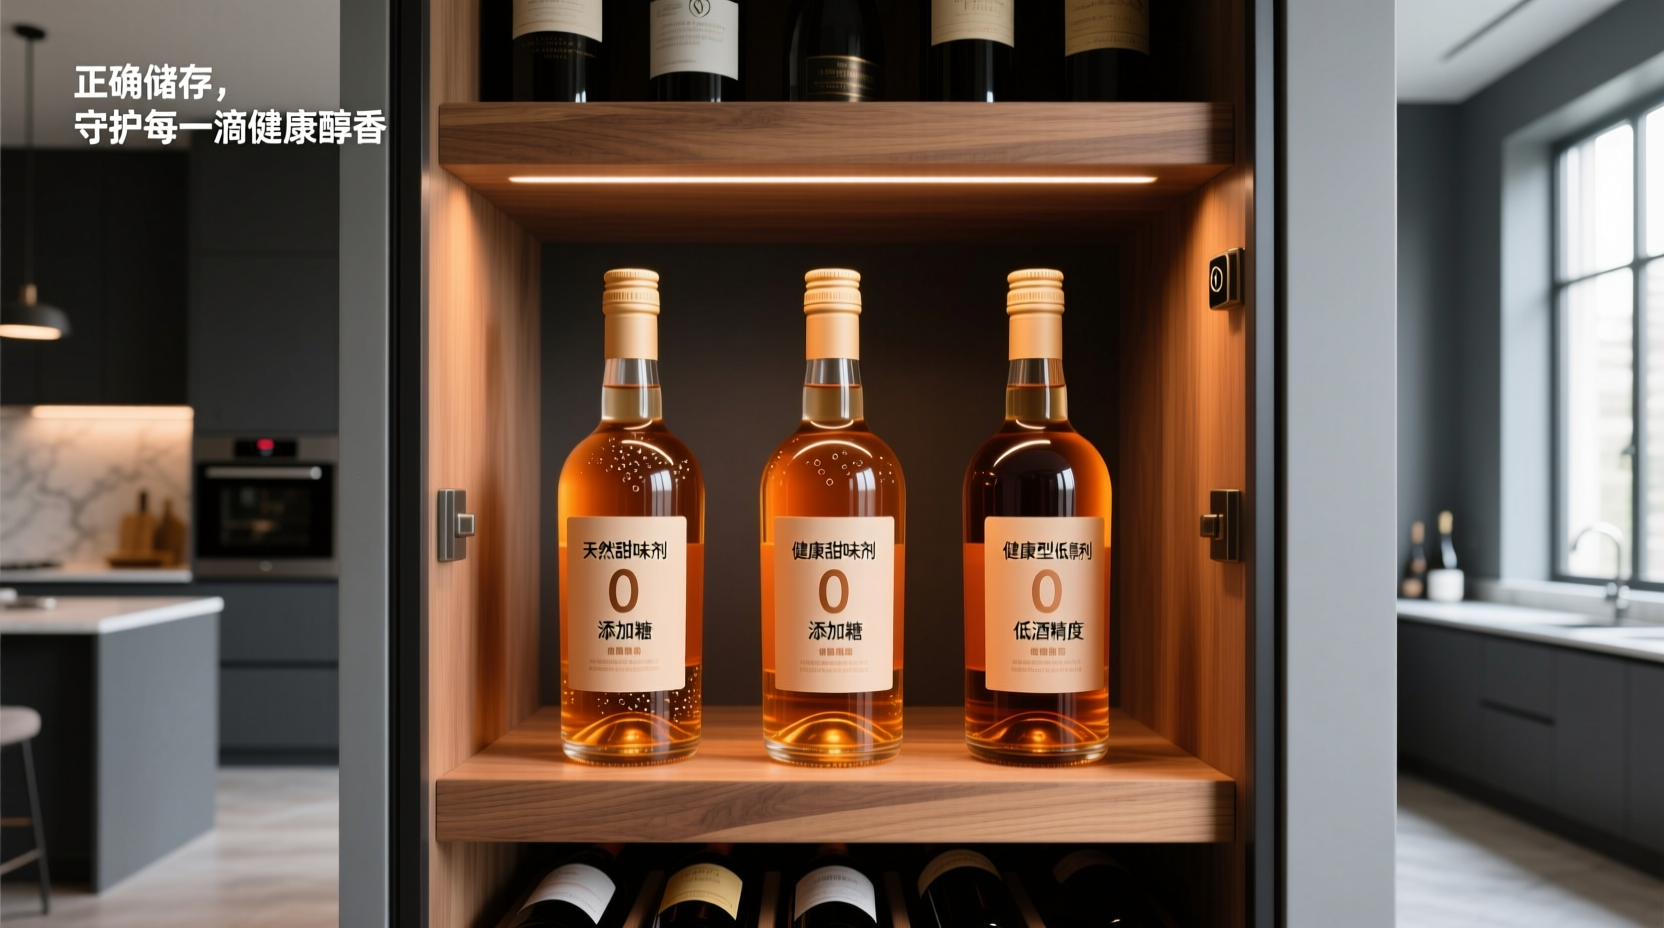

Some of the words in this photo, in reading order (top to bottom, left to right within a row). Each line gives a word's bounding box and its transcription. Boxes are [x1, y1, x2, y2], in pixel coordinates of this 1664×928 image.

[608, 568, 639, 614] 0
[818, 568, 849, 614] 0
[1031, 568, 1062, 614] 0
[597, 620, 652, 641] 添加糖
[808, 620, 863, 641] 添加糖
[1013, 620, 1085, 641] 低酒精度
